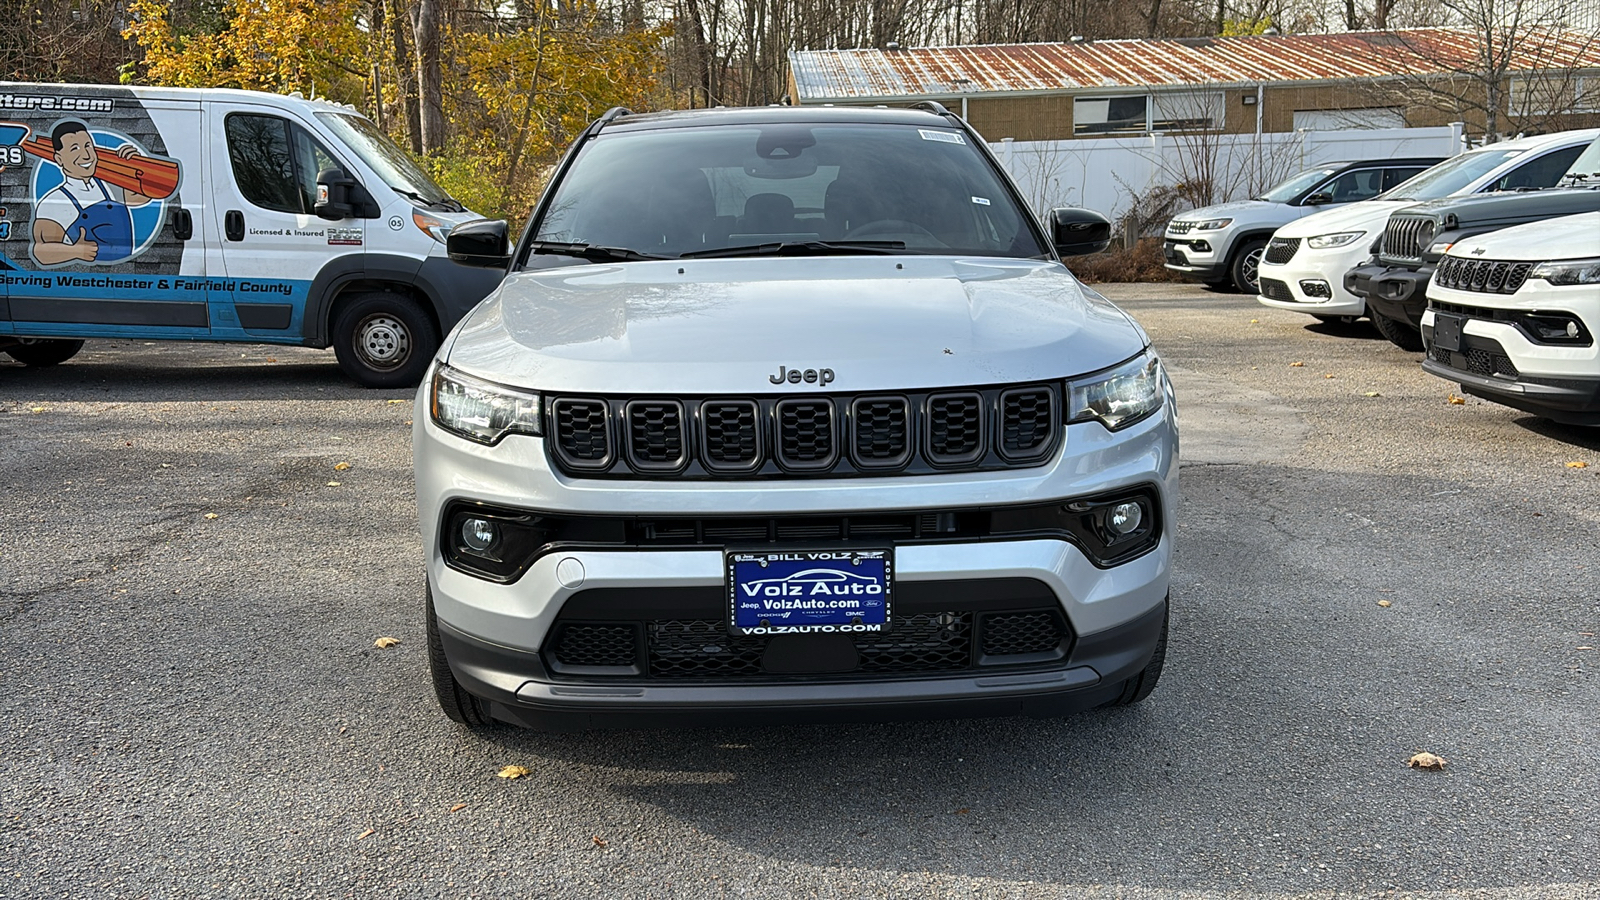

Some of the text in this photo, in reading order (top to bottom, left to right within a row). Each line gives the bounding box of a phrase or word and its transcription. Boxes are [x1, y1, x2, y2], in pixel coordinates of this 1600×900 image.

[249, 228, 283, 236] Licensed
[294, 229, 325, 237] Insured
[0, 274, 293, 296] Serving Westchester & Fairfield County
[769, 365, 835, 387] Jeep
[807, 552, 852, 560] VOLZ
[741, 581, 882, 597] Volz Auto
[763, 599, 860, 610] VolzAuto.com
[741, 624, 881, 636] VOLZAUTO.COM
